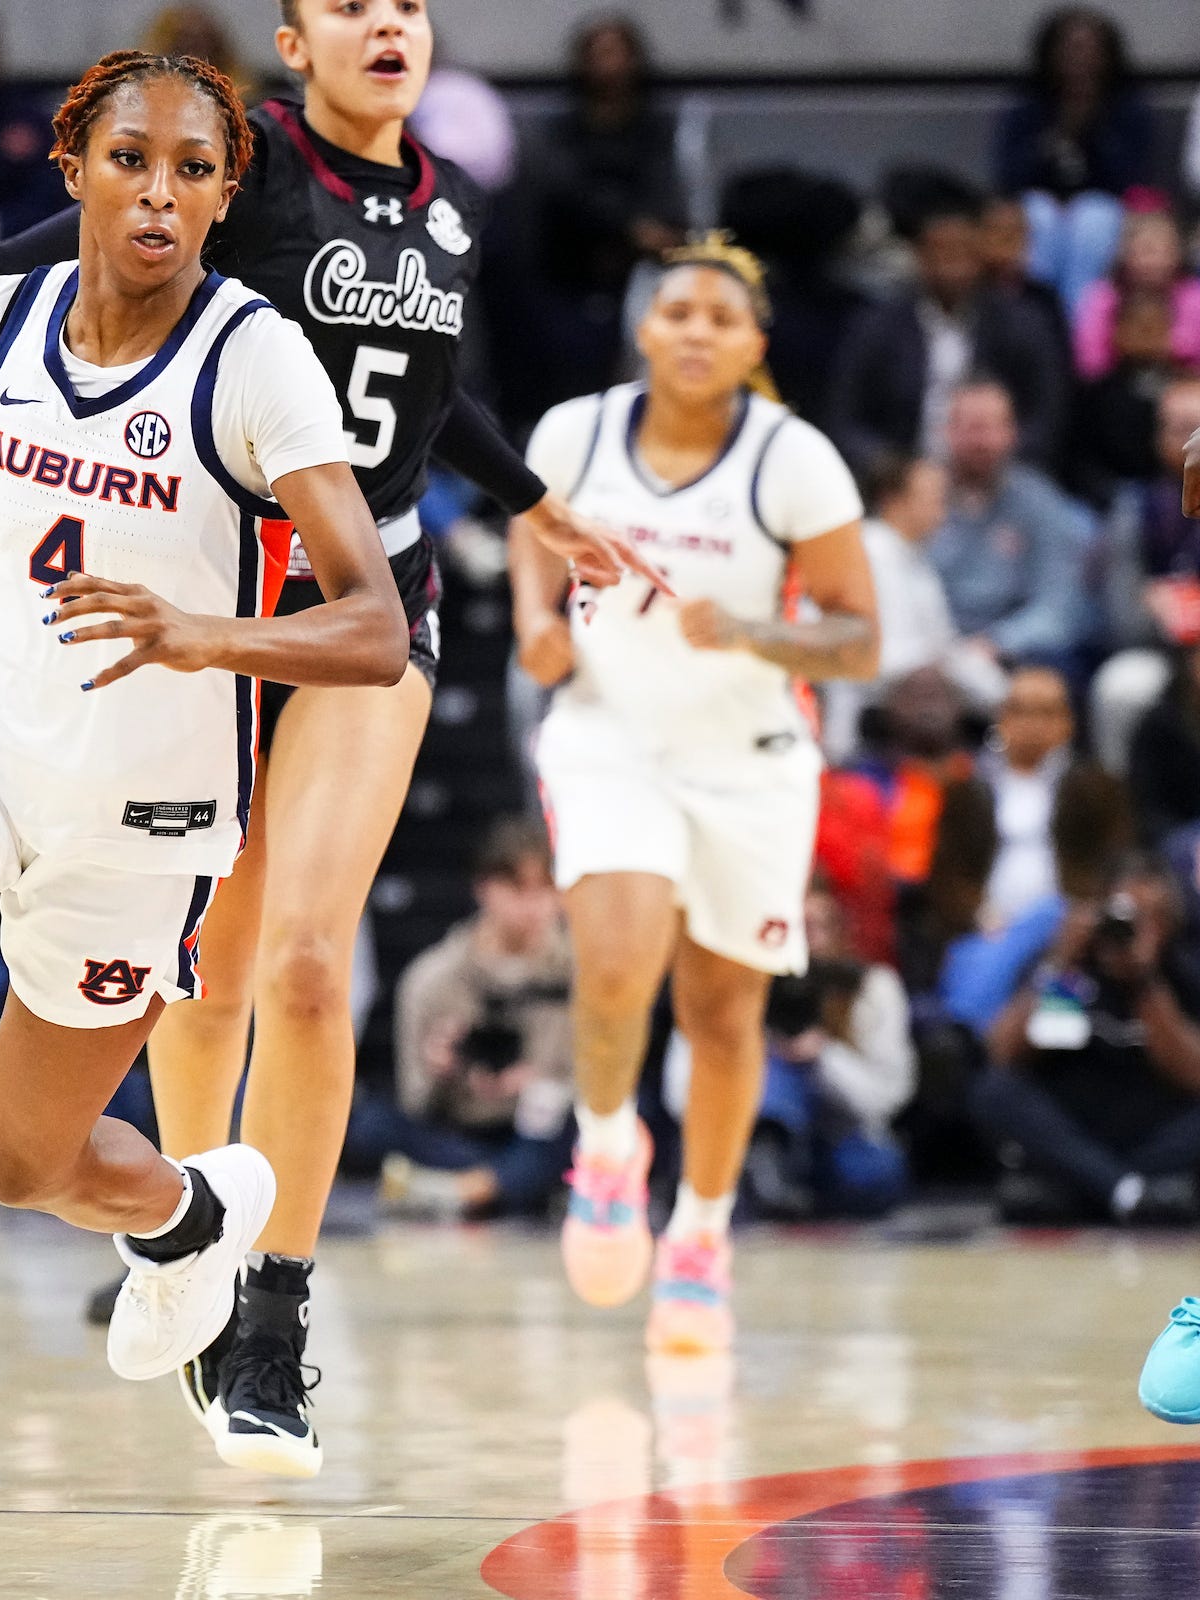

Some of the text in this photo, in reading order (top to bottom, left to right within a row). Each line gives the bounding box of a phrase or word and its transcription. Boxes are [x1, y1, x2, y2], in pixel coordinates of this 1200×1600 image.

[303, 238, 464, 336] Carolina
[127, 412, 169, 457] SEC
[342, 345, 409, 469] 5
[29, 513, 86, 605] 4
[194, 810, 209, 823] 44
